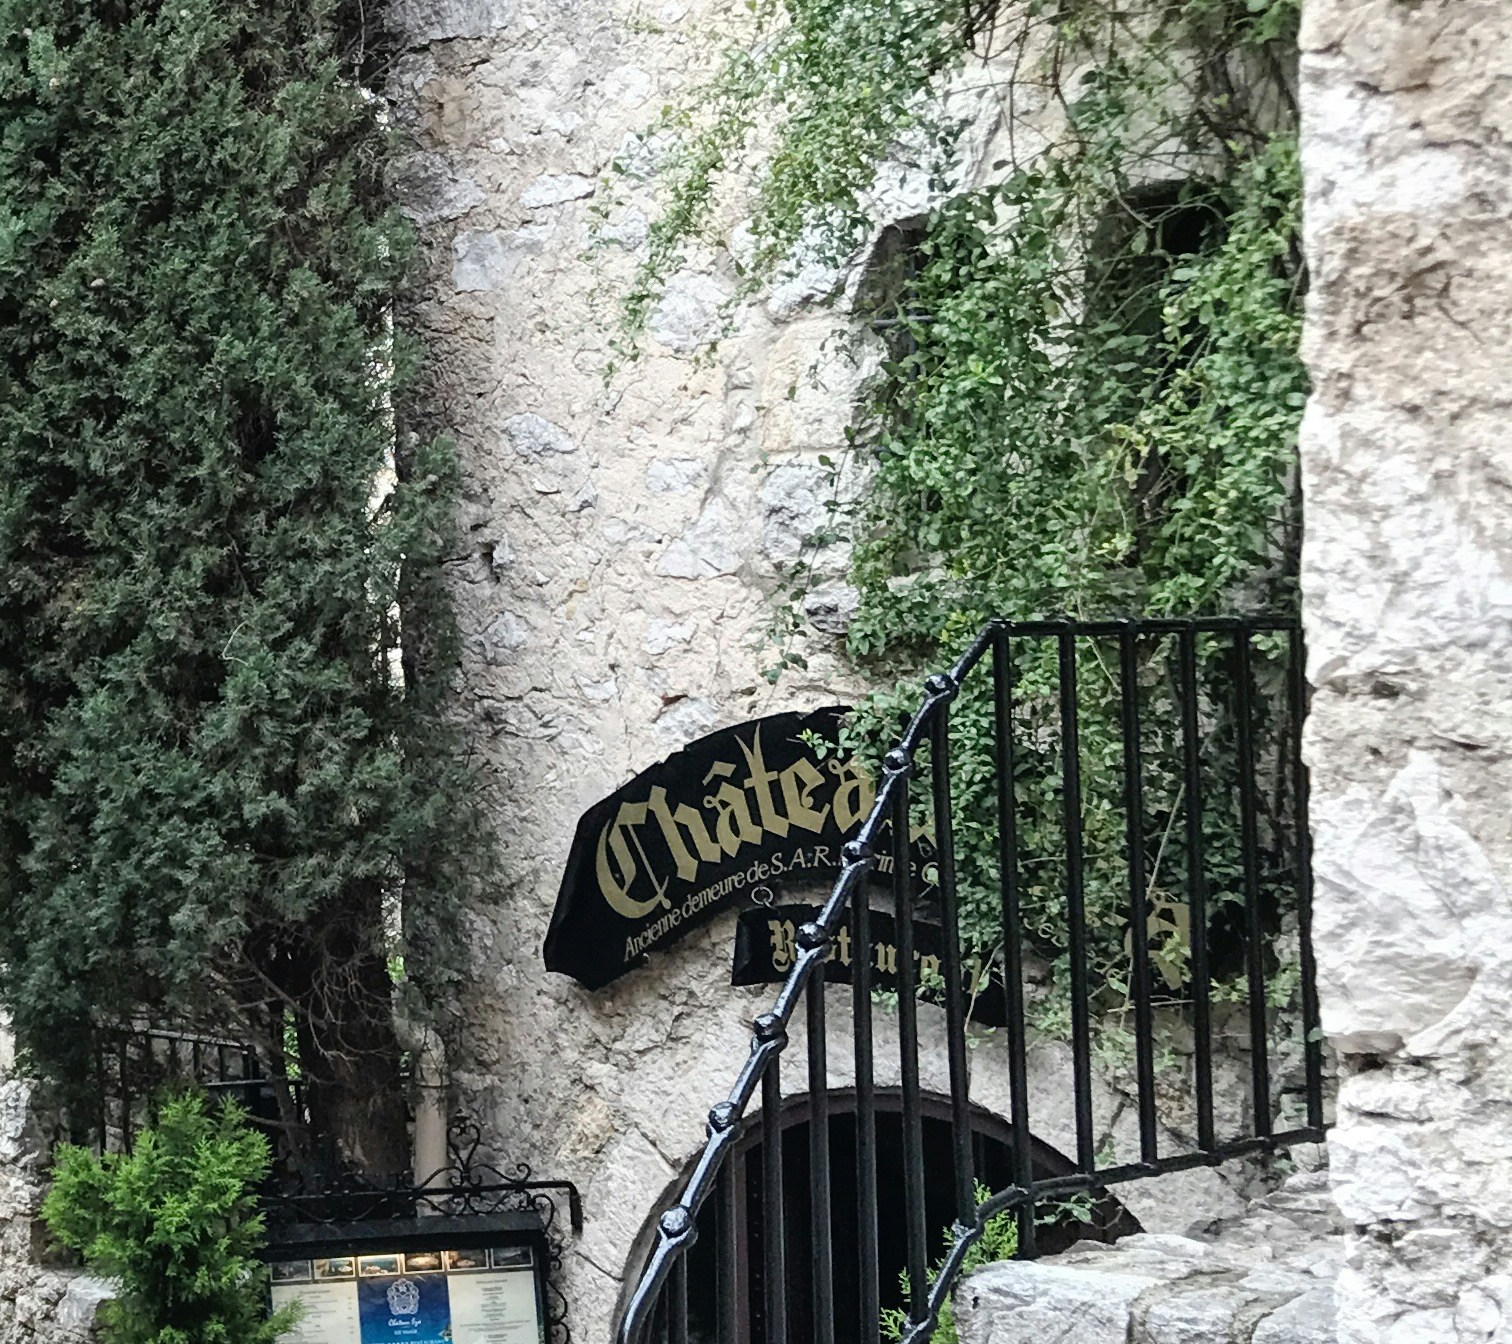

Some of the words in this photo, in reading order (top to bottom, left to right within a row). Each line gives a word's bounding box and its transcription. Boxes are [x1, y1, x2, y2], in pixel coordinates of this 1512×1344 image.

[595, 721, 908, 919] Châtea
[623, 907, 683, 963] Ancienne
[682, 871, 747, 918] demeure
[746, 862, 770, 885] de
